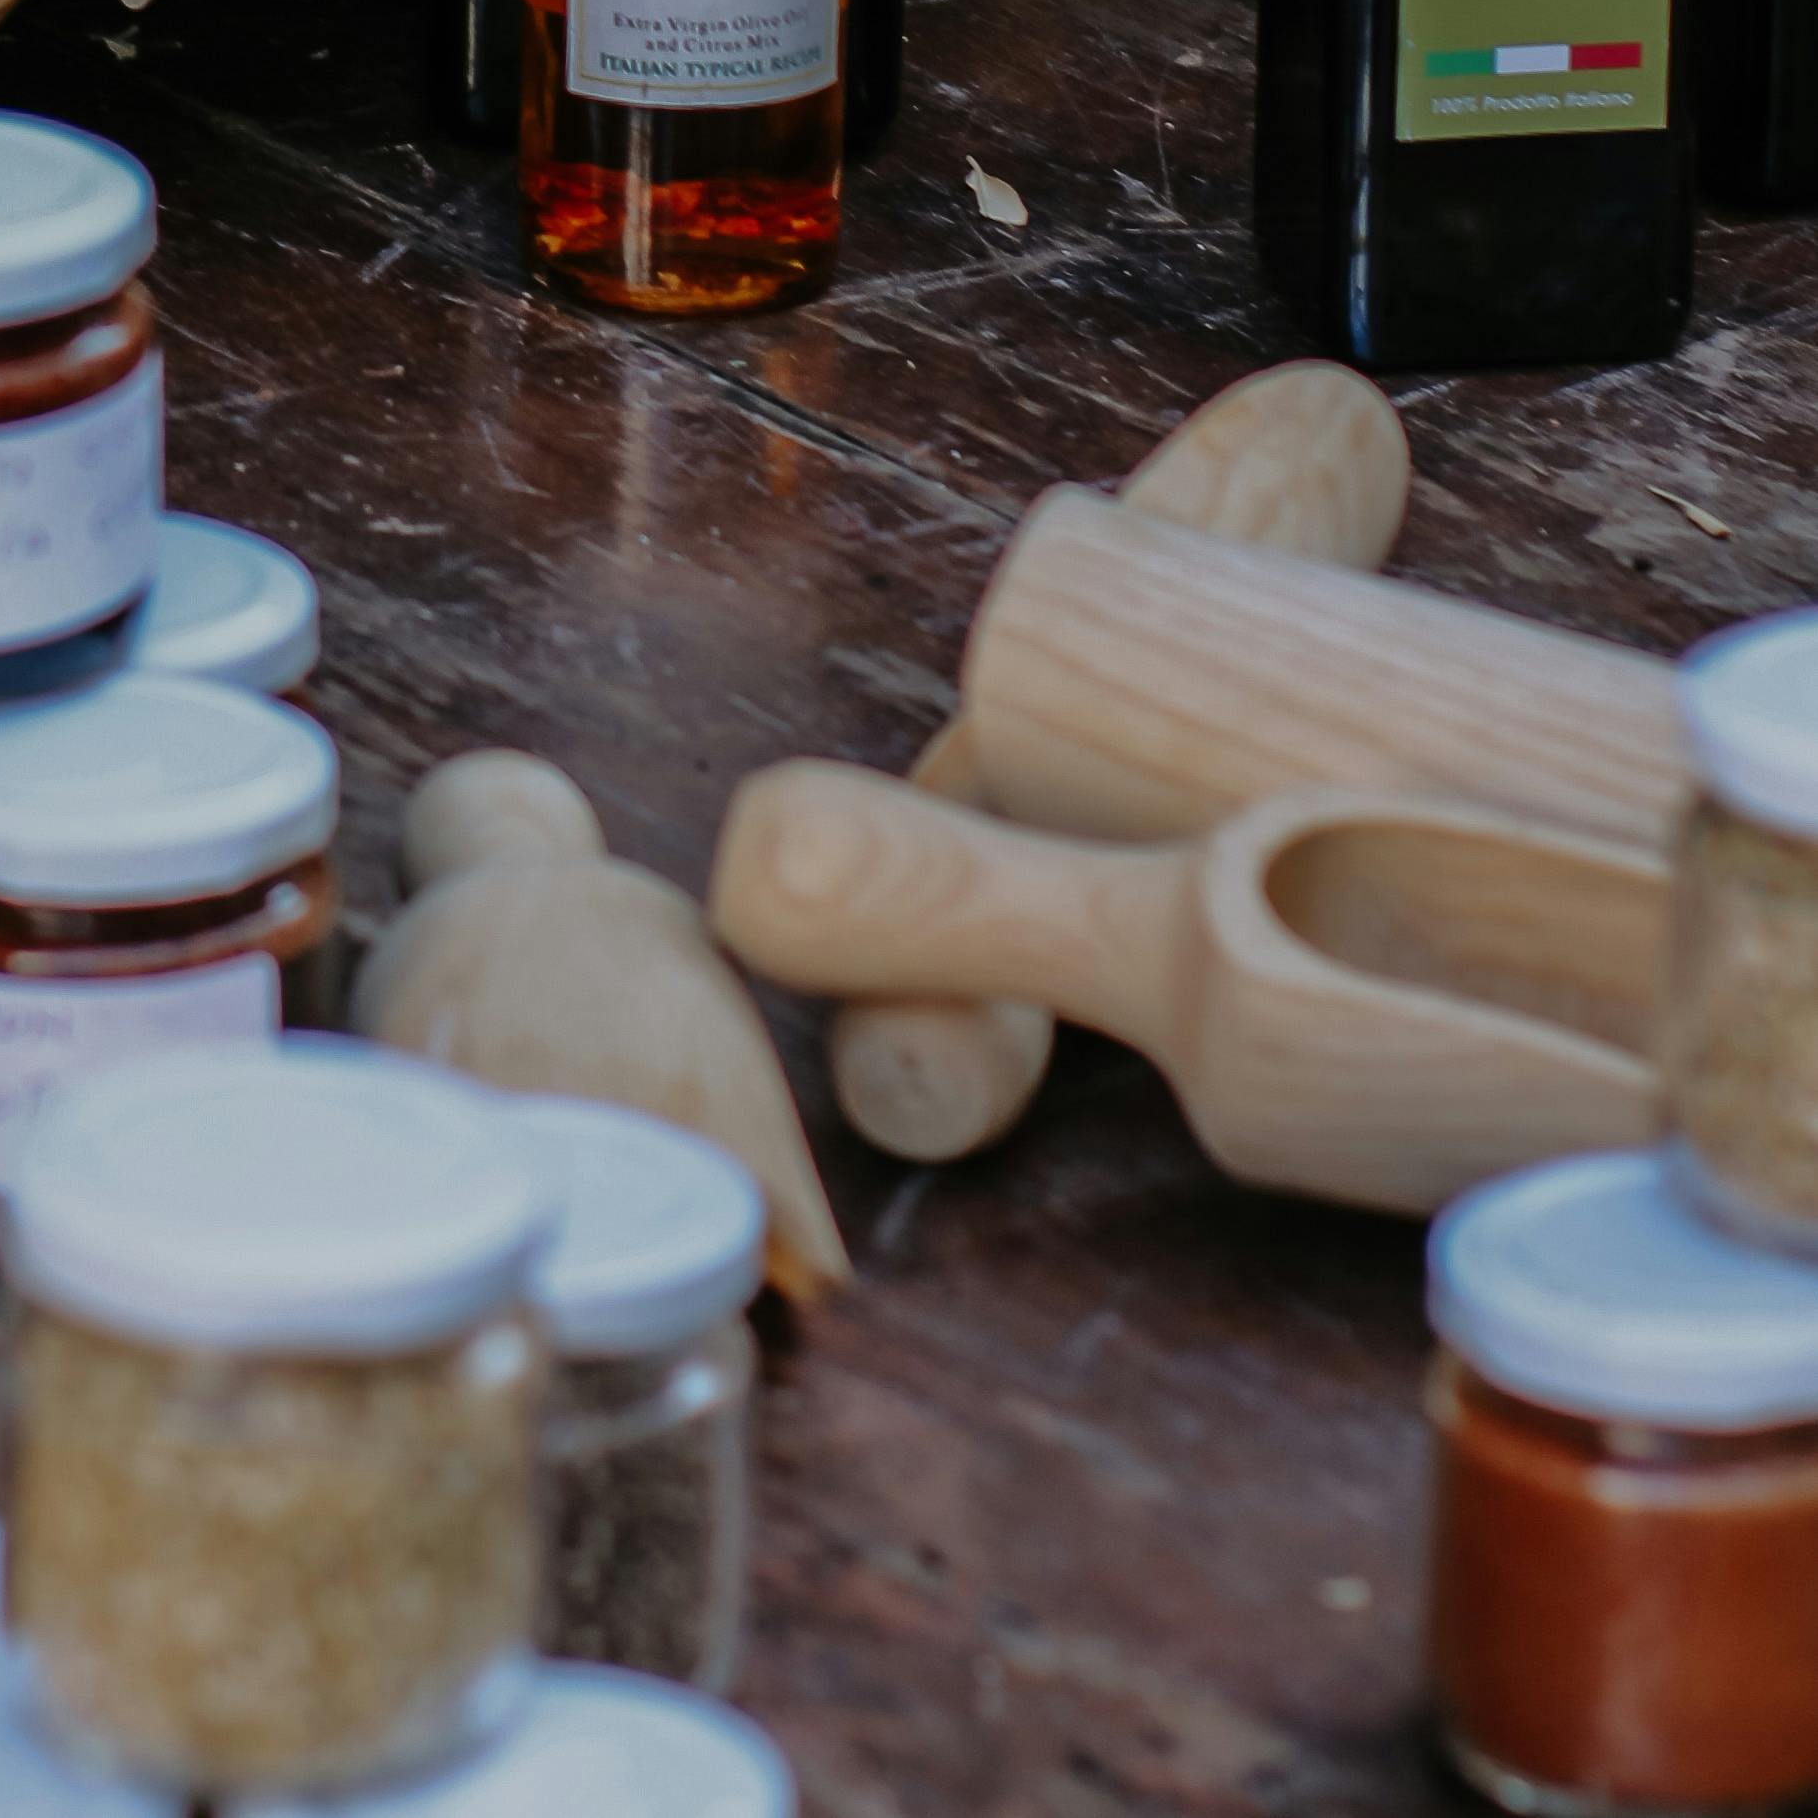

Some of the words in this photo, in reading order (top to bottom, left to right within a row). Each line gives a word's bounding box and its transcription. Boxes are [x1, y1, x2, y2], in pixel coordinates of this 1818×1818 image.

[645, 37, 679, 52] and
[599, 51, 678, 77] ITALIAN
[684, 59, 763, 78] TYPICAL
